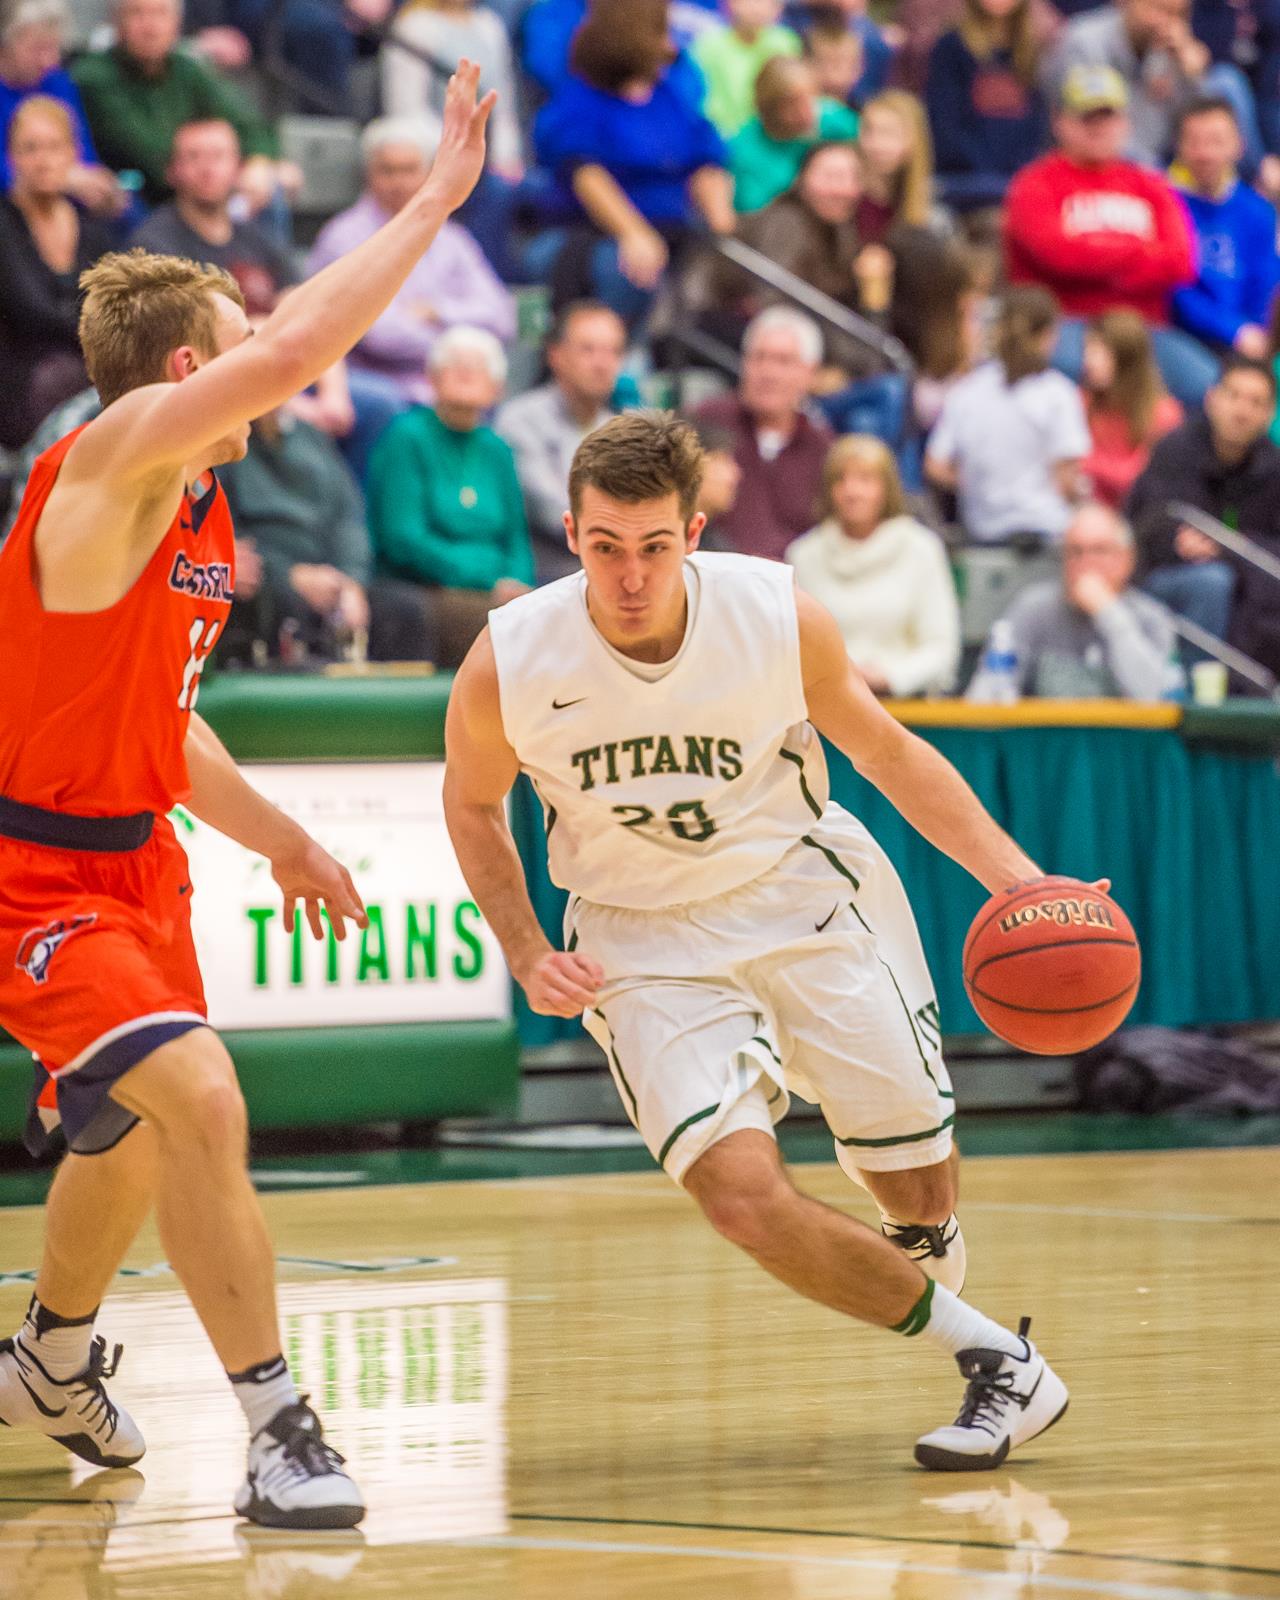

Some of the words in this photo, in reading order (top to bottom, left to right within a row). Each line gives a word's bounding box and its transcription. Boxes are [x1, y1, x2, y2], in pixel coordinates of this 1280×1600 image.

[571, 735, 743, 791] TITANS
[247, 901, 484, 985] TITANS
[999, 899, 1117, 935] Wilson
